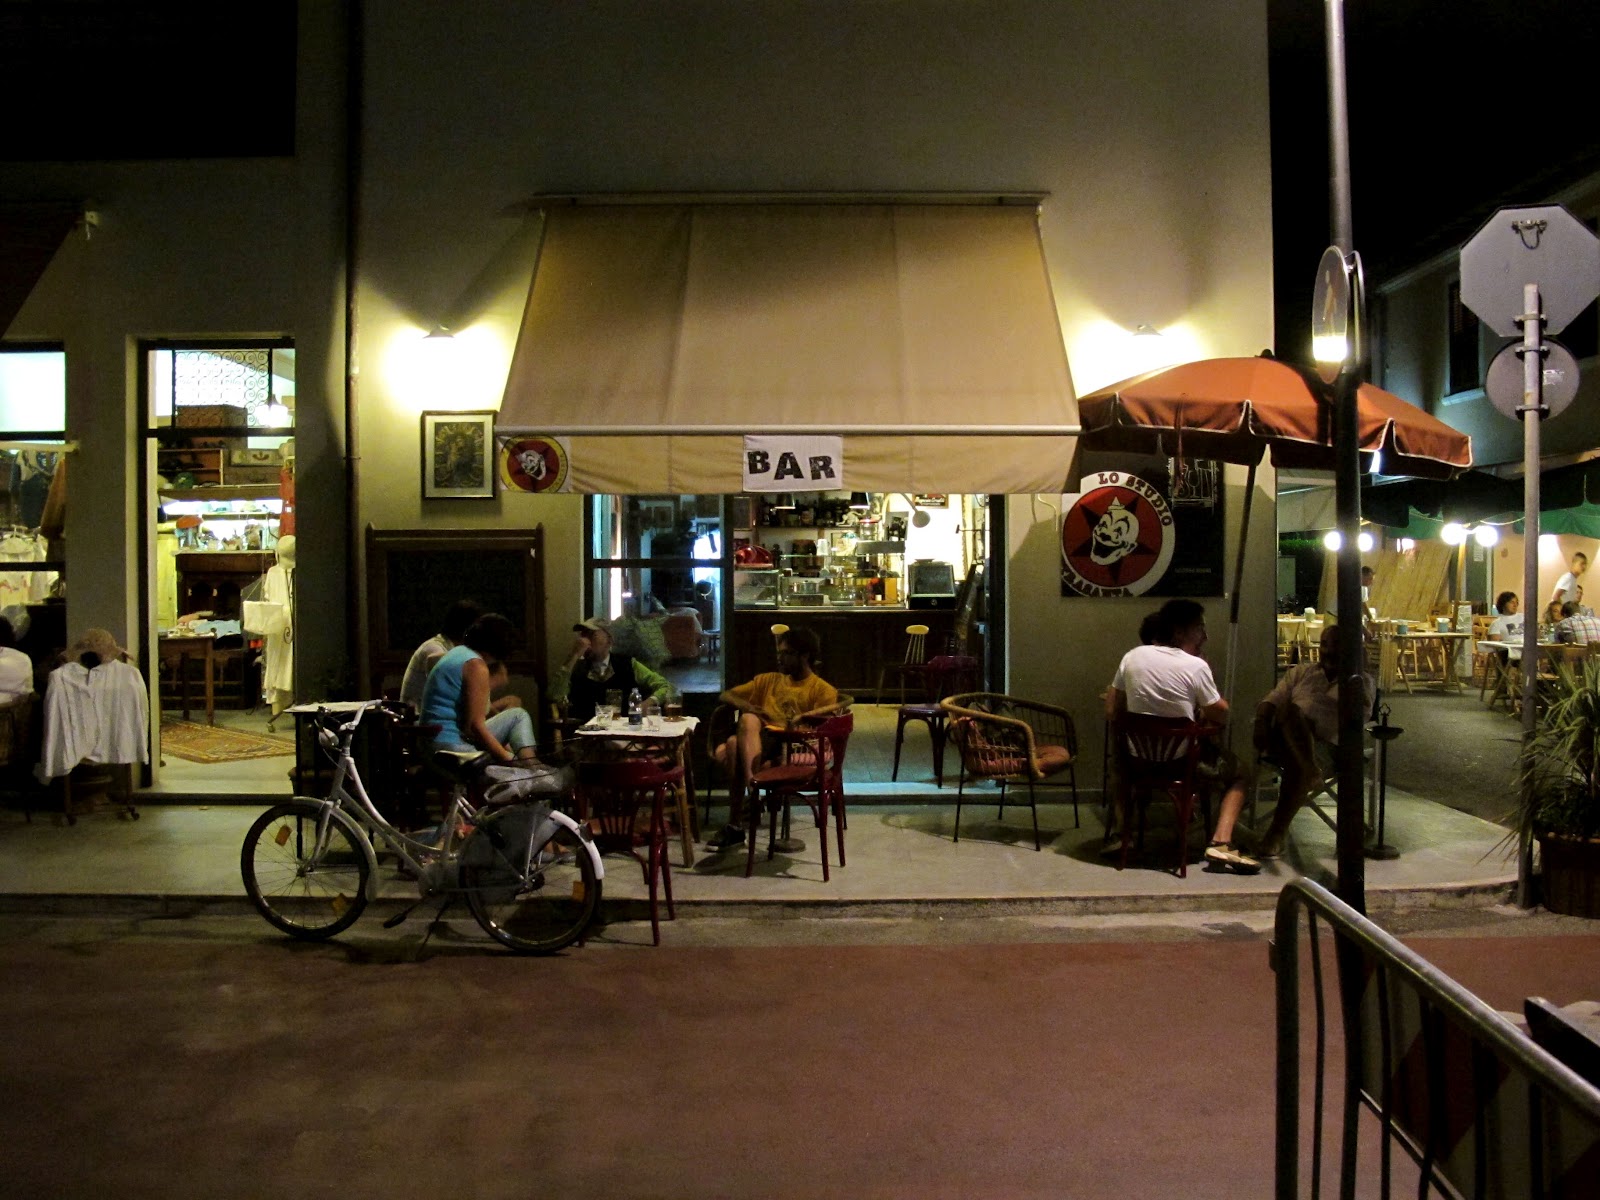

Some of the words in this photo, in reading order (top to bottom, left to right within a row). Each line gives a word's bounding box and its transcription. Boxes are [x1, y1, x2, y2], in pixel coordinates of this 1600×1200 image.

[747, 450, 835, 481] BAR
[1098, 472, 1119, 485] LO
[1125, 476, 1172, 526] STUDIO
